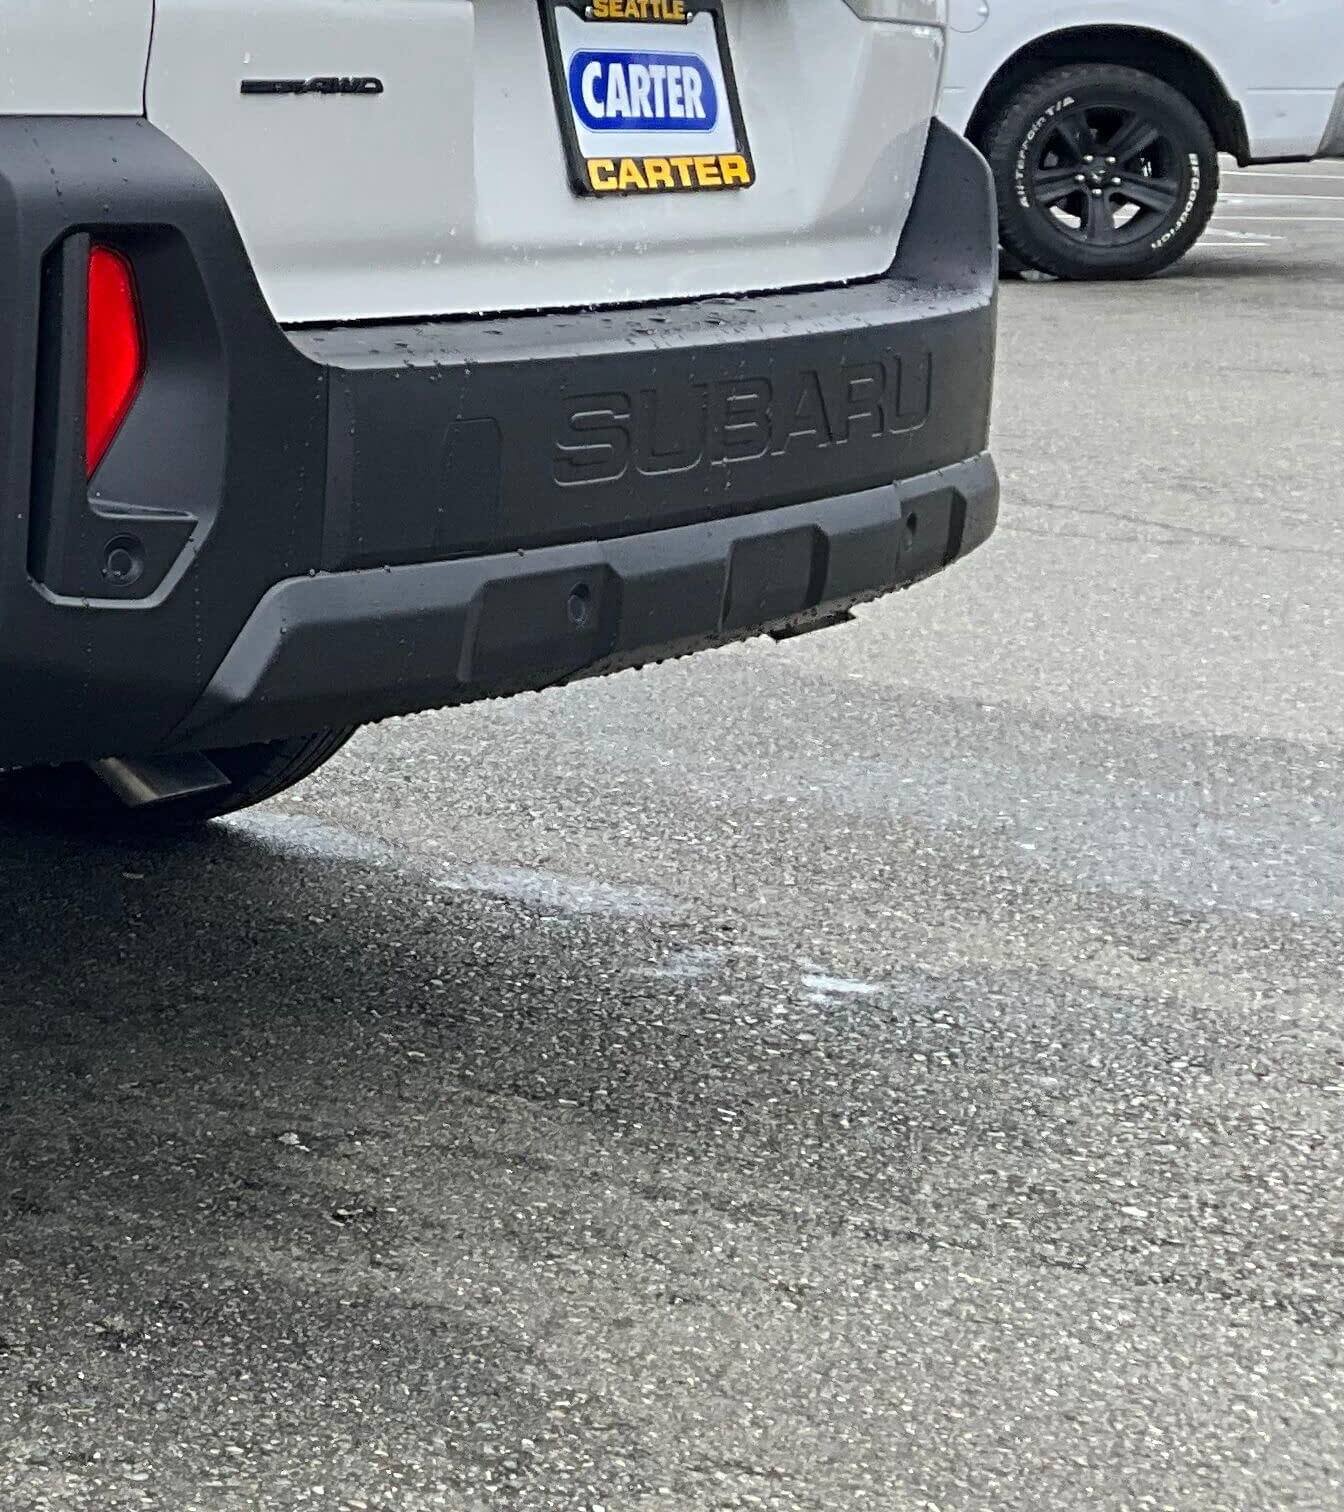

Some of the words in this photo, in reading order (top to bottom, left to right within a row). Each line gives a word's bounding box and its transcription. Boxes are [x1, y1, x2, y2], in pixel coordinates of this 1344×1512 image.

[581, 60, 706, 119] CARTER
[586, 154, 751, 191] CARTER
[552, 351, 933, 487] SUBARU
